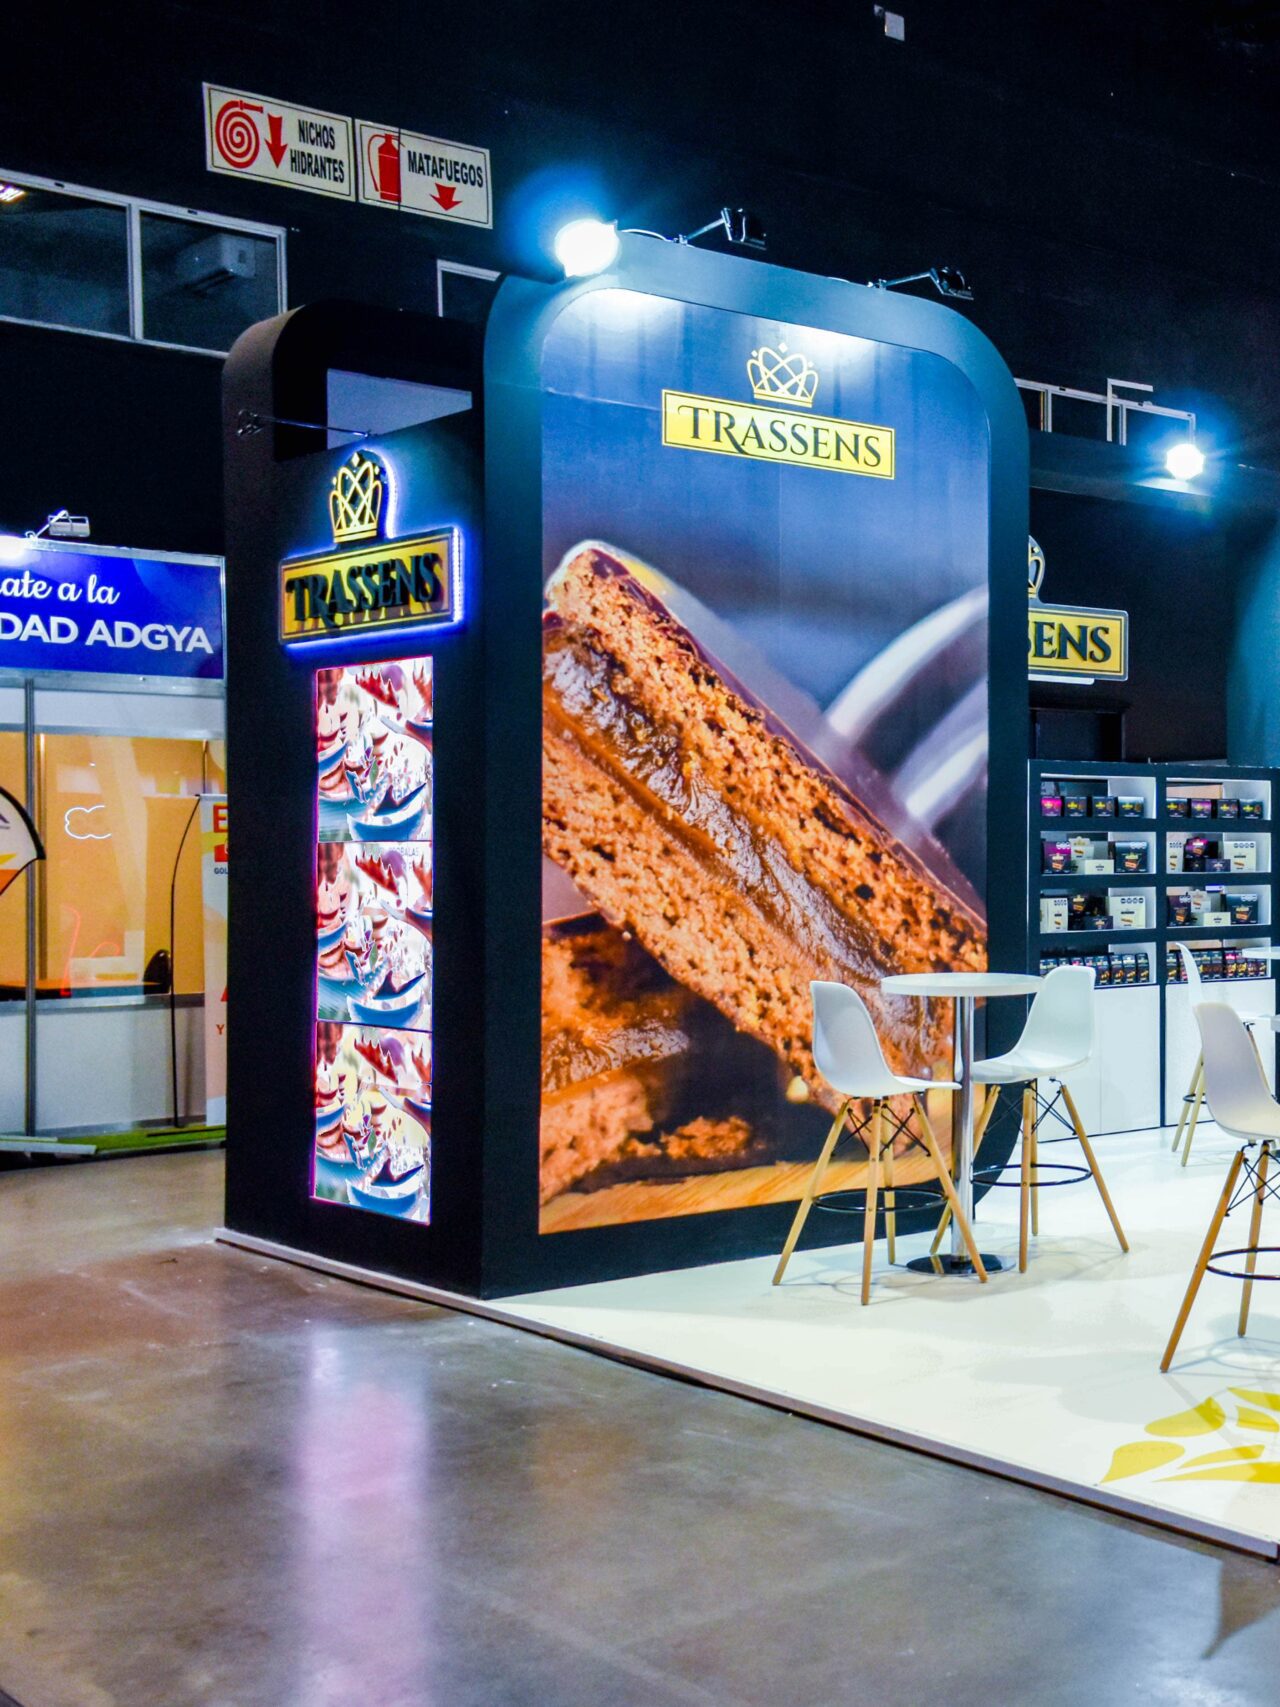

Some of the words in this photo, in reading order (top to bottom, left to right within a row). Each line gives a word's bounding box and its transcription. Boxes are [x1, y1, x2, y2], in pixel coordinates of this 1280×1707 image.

[298, 119, 336, 150] NICHOS
[290, 149, 345, 184] HIDRANTES
[407, 151, 484, 188] MATAFUEGOS
[677, 405, 881, 467] TRASSENS
[58, 581, 82, 602] a
[87, 574, 120, 605] la
[286, 553, 442, 629] TRASSENS
[85, 619, 214, 654] ADGYA
[1030, 620, 1112, 663] ENS
